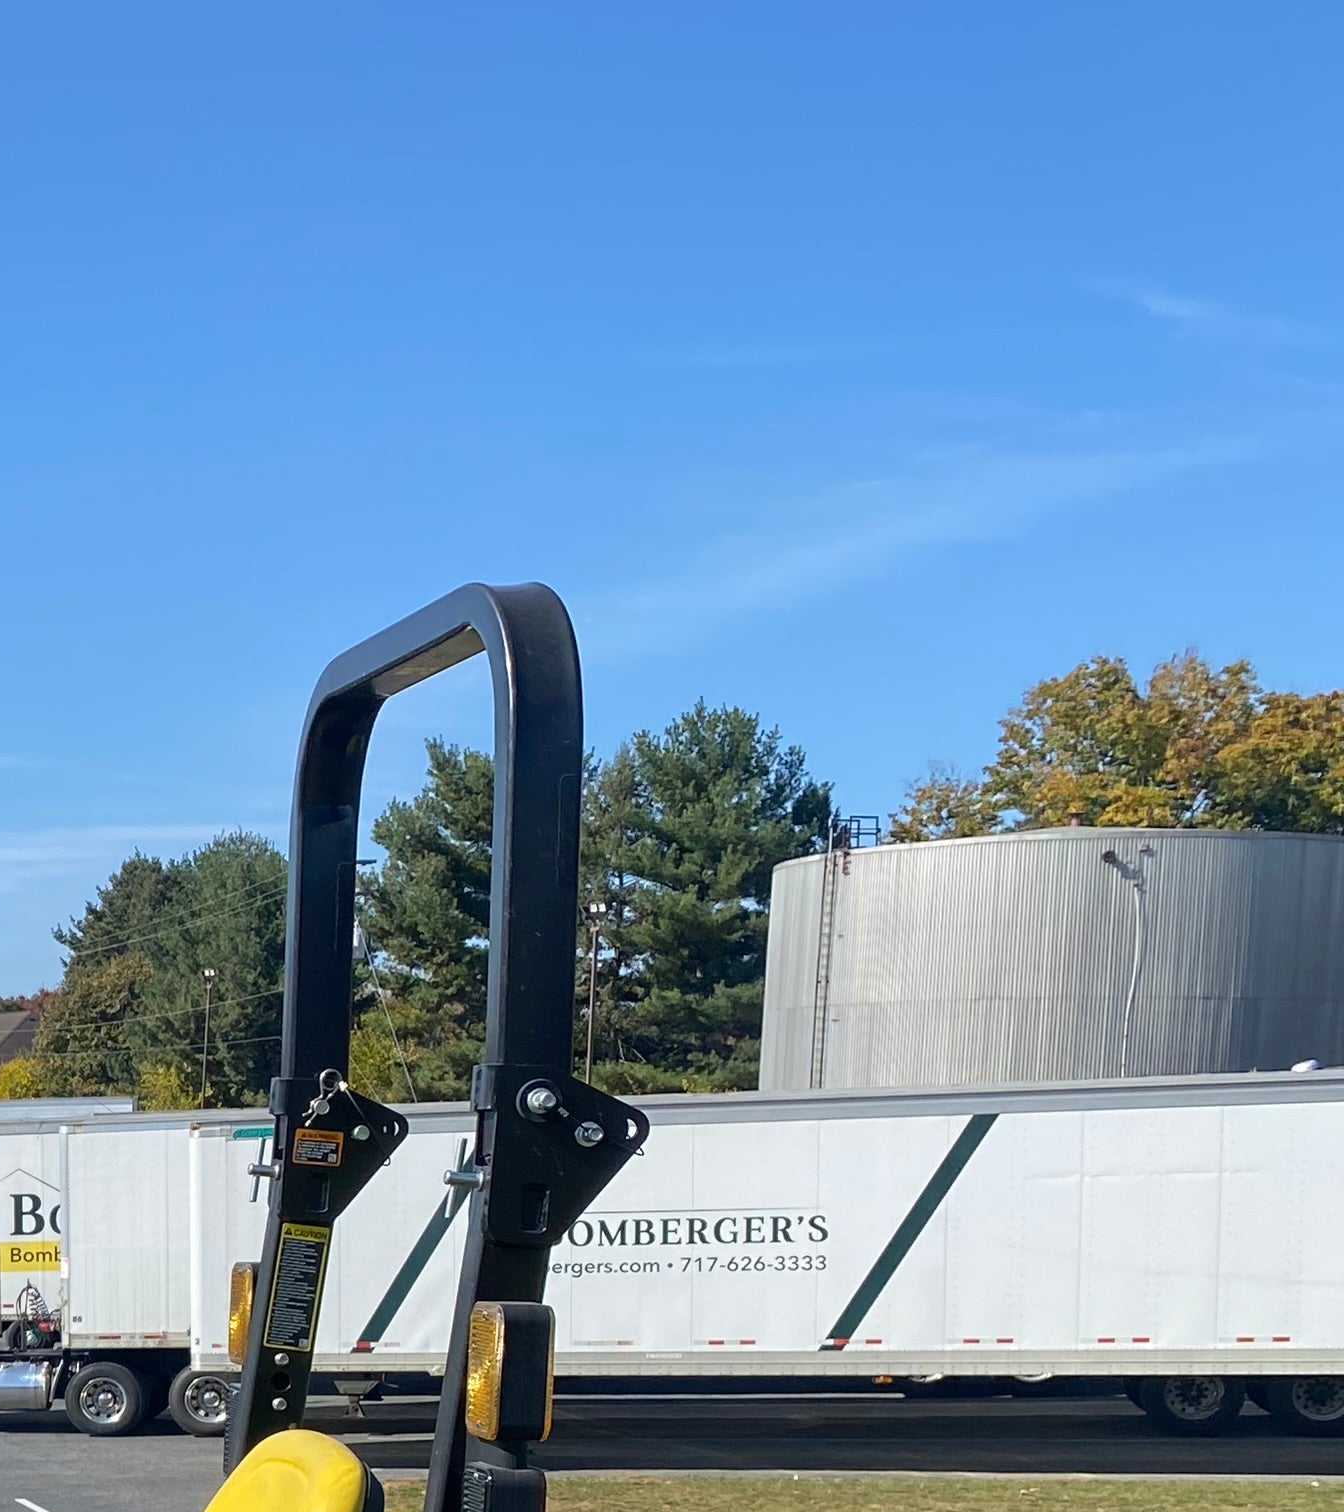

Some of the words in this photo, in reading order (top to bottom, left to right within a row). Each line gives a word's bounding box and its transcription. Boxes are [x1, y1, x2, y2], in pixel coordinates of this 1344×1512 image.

[293, 1228, 328, 1240] CAUTION
[553, 1215, 829, 1247] OMBERGER'S
[548, 1259, 661, 1278] ergers.com
[680, 1255, 828, 1273] 717-626-3333
